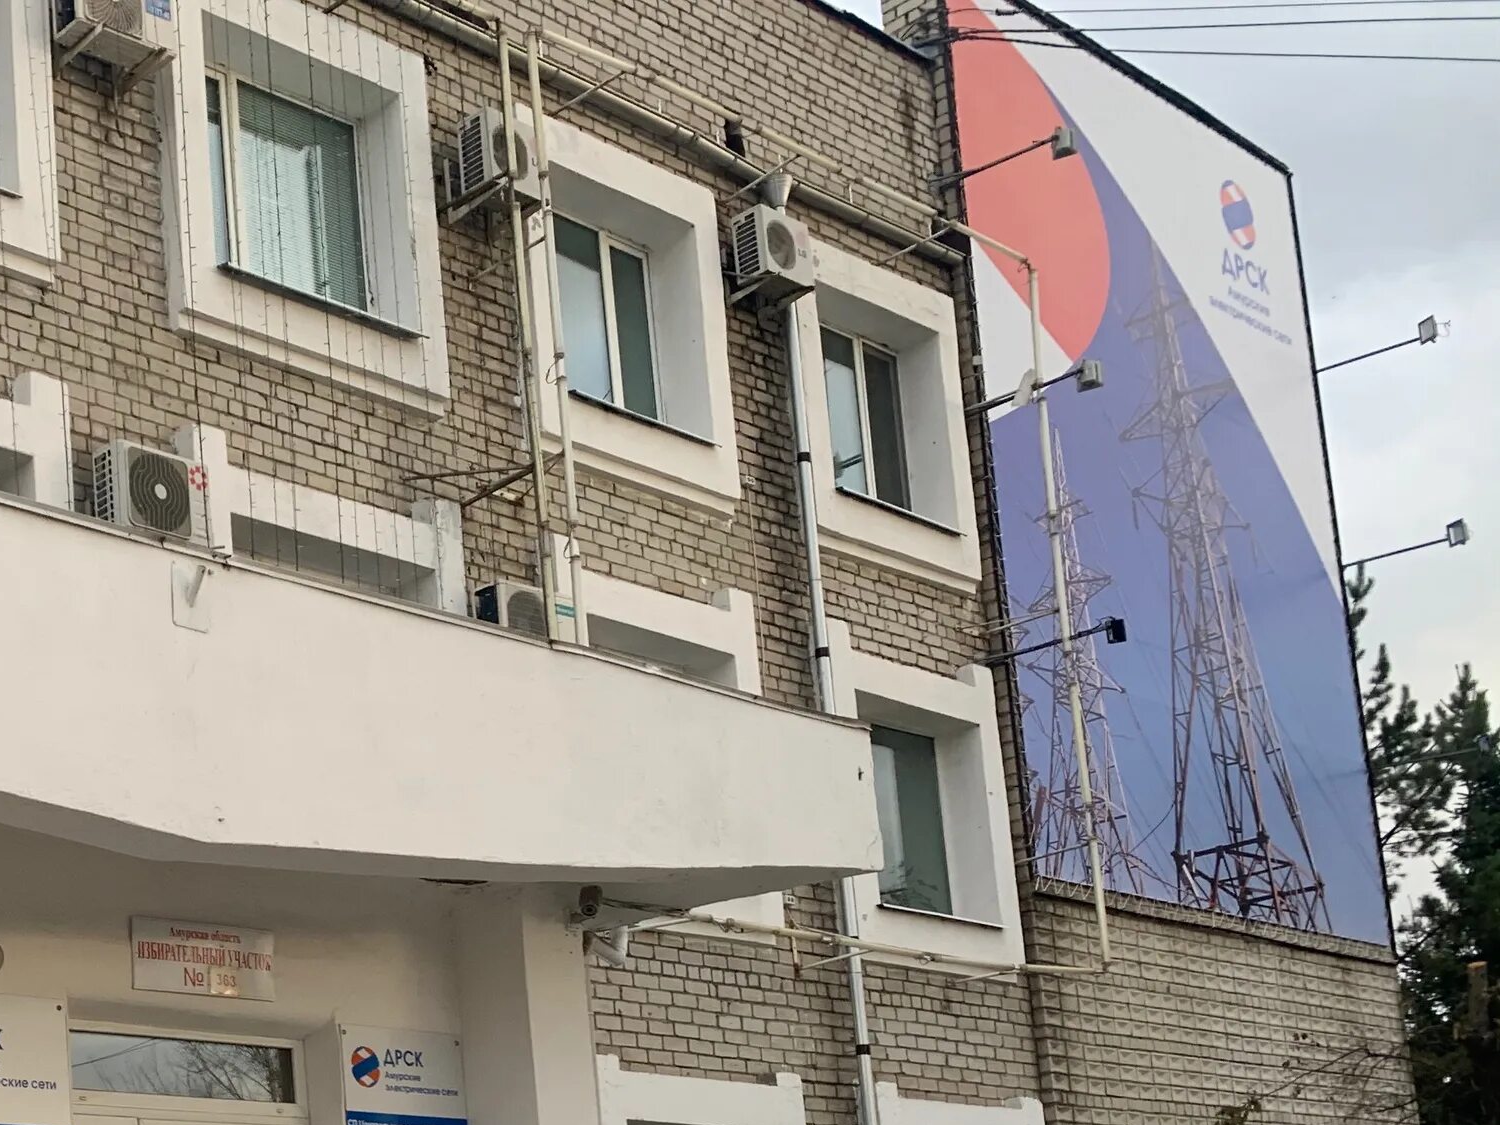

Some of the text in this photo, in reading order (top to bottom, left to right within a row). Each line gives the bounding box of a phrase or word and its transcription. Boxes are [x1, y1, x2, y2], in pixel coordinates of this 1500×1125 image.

[1222, 248, 1270, 295] ДРСК
[211, 930, 242, 944] область
[137, 941, 271, 971] ИЗБИРАТЕЛЬНЫЙ УЧАСТОК
[383, 1049, 424, 1067] ДРСК
[31, 1079, 57, 1090] сети
